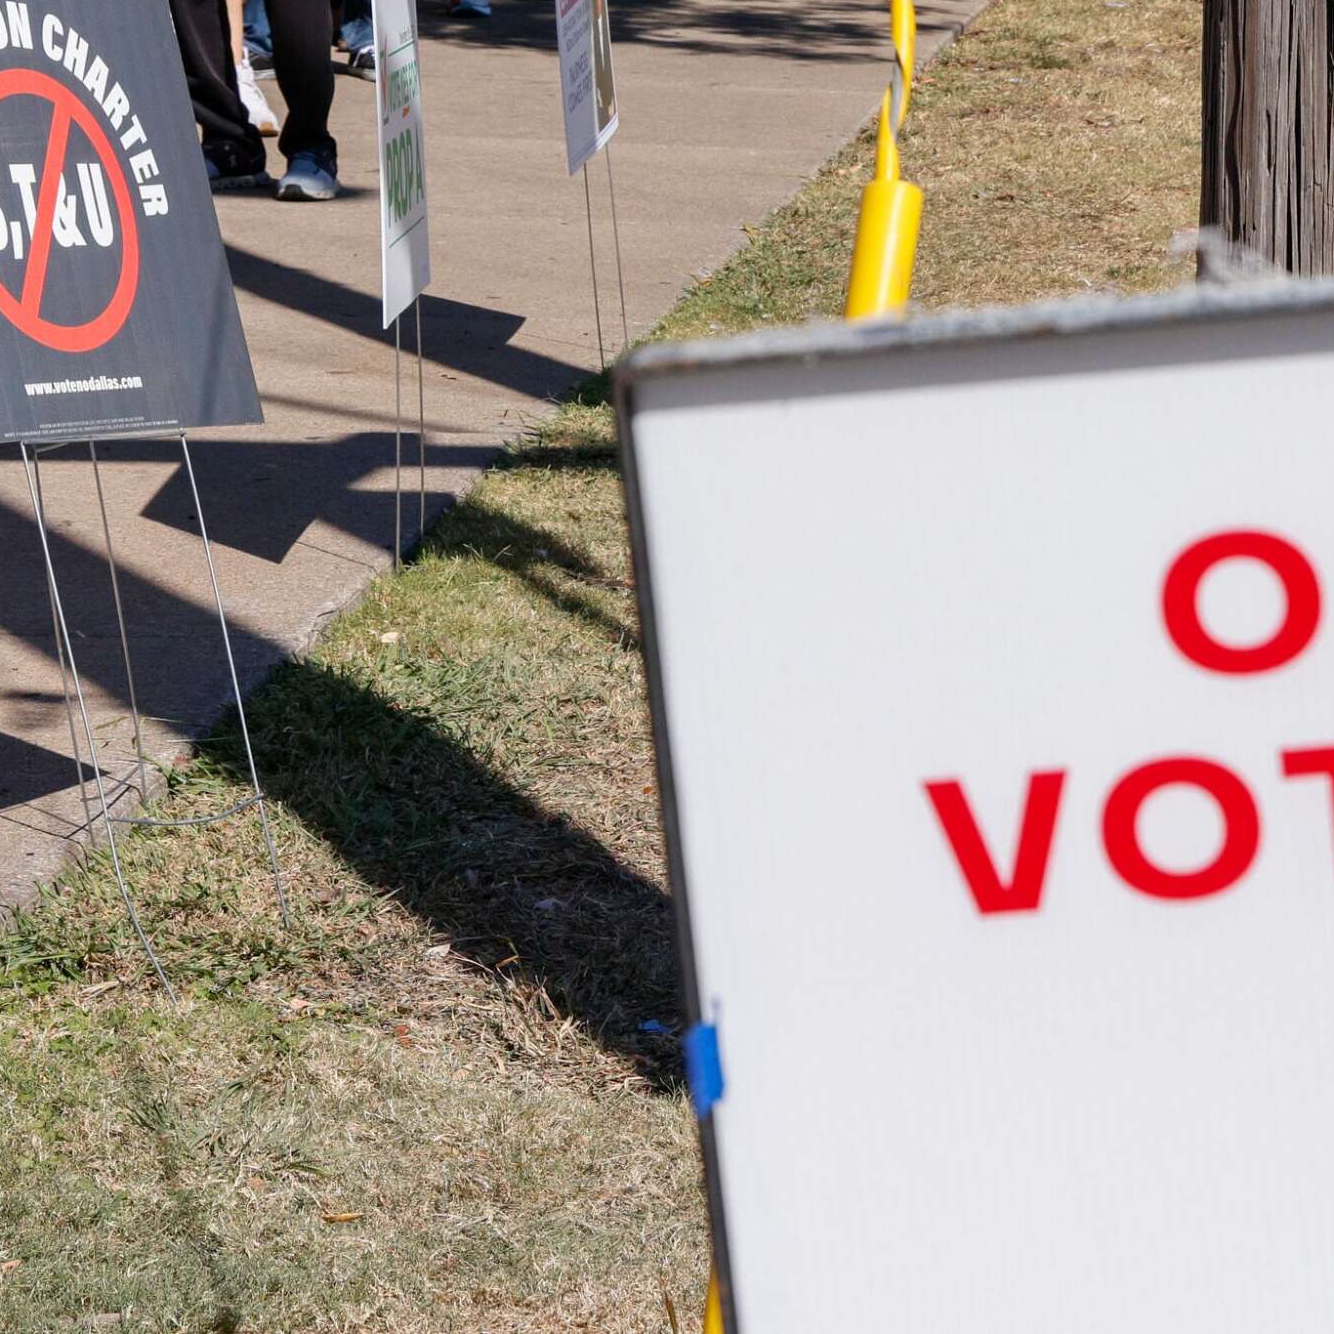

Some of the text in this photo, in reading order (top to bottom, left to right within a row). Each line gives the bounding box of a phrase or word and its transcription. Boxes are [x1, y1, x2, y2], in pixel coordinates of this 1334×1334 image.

[41, 12, 169, 218] CHARTER
[385, 128, 414, 228] PROP
[24, 375, 144, 396] www.votenodallas.com
